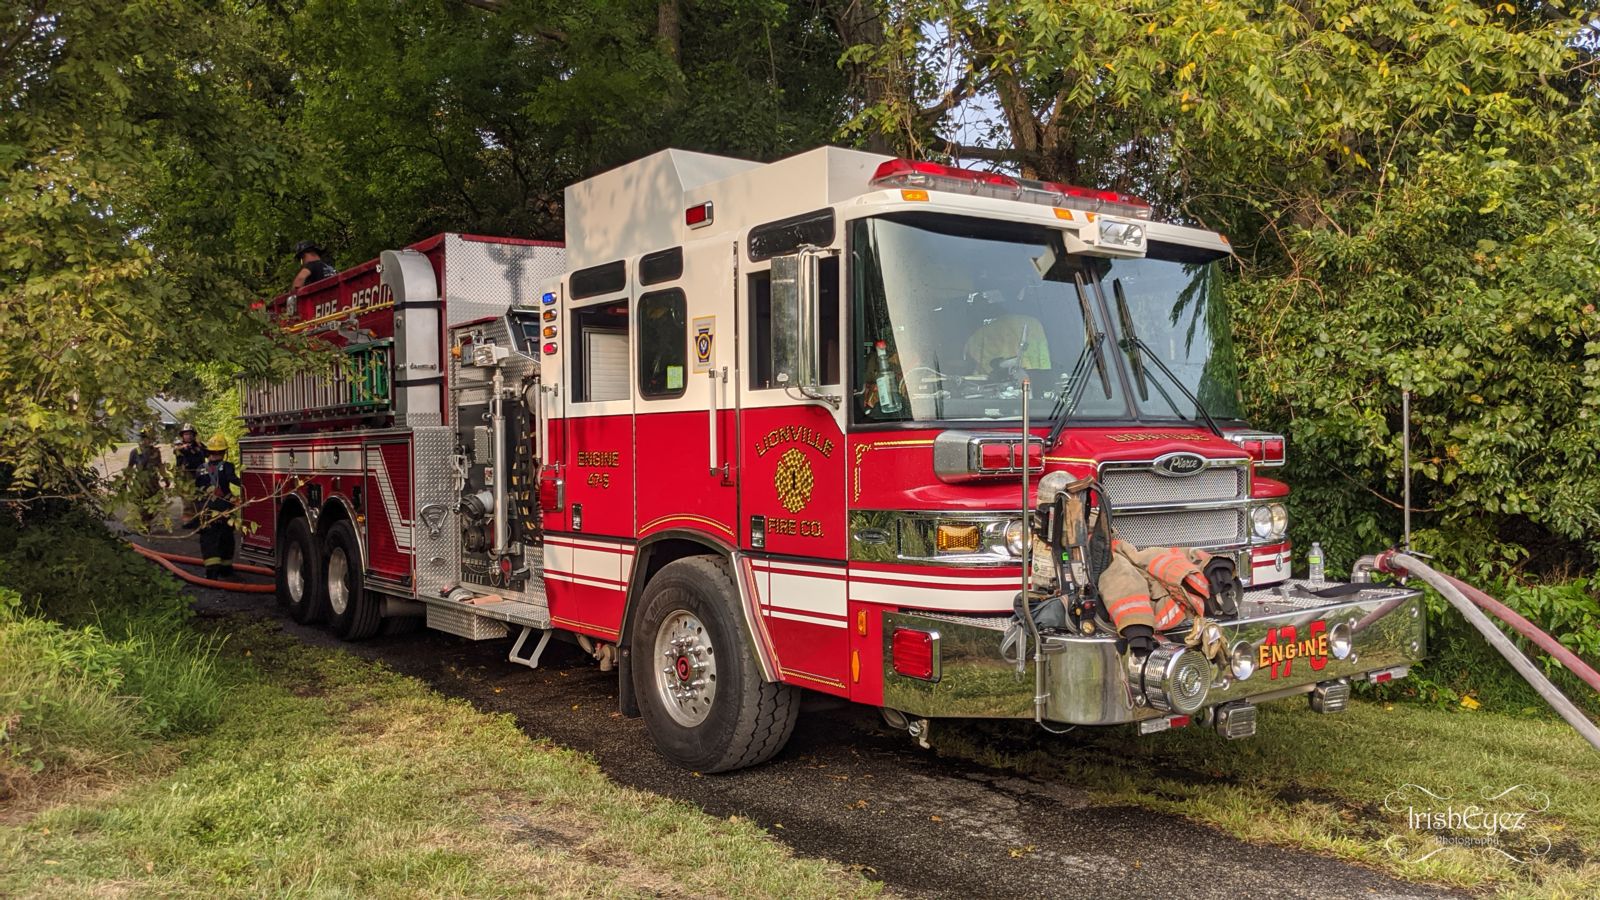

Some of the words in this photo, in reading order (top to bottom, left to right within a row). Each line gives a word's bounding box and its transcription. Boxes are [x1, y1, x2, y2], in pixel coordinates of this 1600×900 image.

[757, 426, 834, 455] LIONVILLE
[578, 451, 619, 467] ENGINE
[1169, 456, 1198, 471] Pierce
[588, 473, 609, 489] 47-5
[768, 518, 797, 534] FIRE
[800, 520, 824, 537] CO.
[1259, 634, 1328, 670] ENGINE
